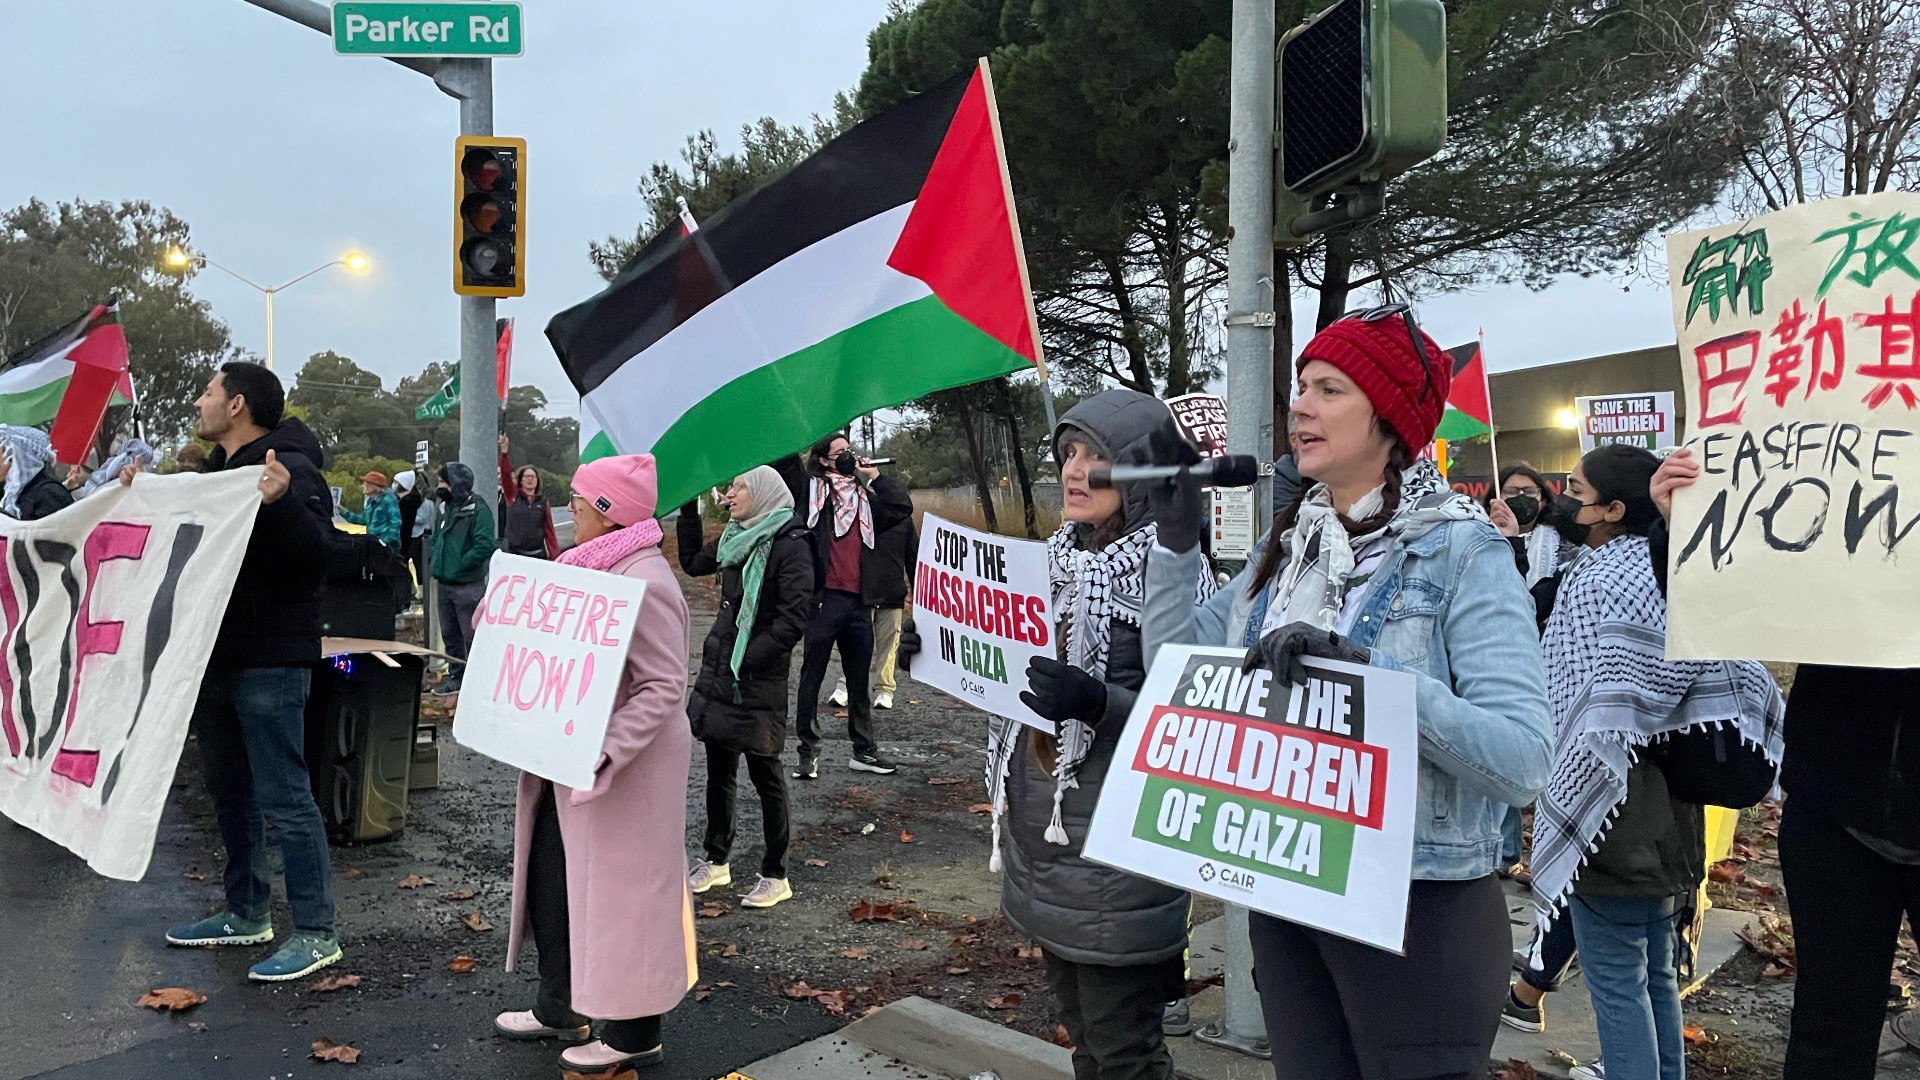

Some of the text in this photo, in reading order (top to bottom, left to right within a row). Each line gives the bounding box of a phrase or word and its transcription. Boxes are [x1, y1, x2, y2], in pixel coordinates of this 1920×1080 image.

[345, 14, 510, 43] Parker Rd
[1589, 414, 1660, 434] CHILDREN
[1594, 398, 1652, 415] SAVE THE
[934, 526, 1008, 584] STOP THE
[1674, 474, 1920, 575] NOW
[484, 574, 628, 647] CEASEFIRE
[915, 560, 1049, 647] MASSACRES
[939, 625, 1009, 684] IN GAZA
[493, 643, 595, 736] NOW!
[968, 681, 985, 696] CAIR
[1184, 663, 1352, 736] SAVE THE
[1145, 712, 1374, 818] CHILDREN
[1156, 787, 1322, 878] OF GAZA
[1220, 868, 1256, 889] CAIR
